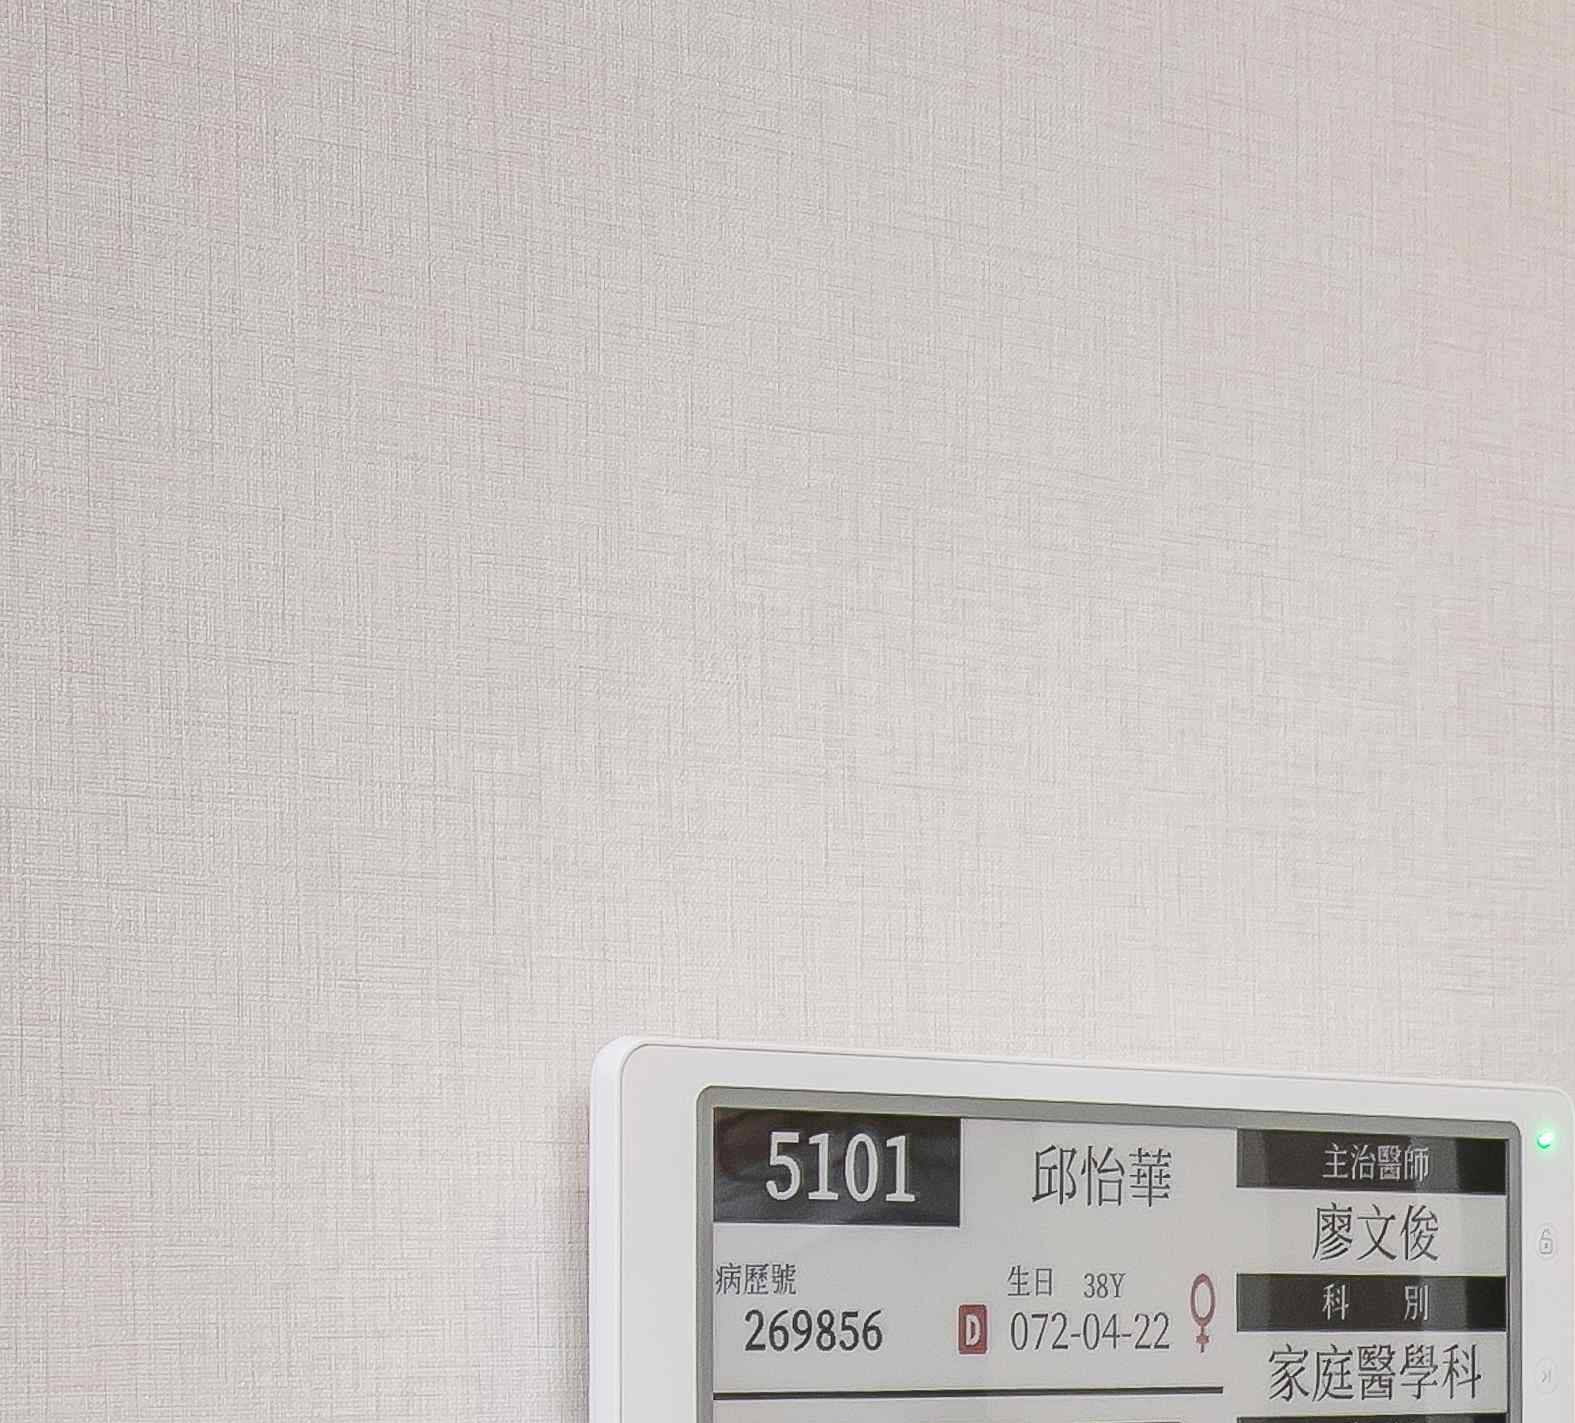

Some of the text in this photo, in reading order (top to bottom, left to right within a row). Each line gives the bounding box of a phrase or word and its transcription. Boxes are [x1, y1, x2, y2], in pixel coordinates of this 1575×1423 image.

[764, 1130, 916, 1203] 5101
[1031, 1144, 1173, 1208] 邱怡華
[1321, 1143, 1431, 1183] 主治醫師
[1312, 1201, 1440, 1262] 廖文俊
[714, 1262, 797, 1298] 病歷號
[1006, 1264, 1127, 1299] 生日 38Y
[744, 1308, 883, 1353] 269856
[964, 1313, 982, 1347] D
[1009, 1312, 1171, 1353] 072-04-22
[1268, 1343, 1482, 1403] 家庭醫學科
